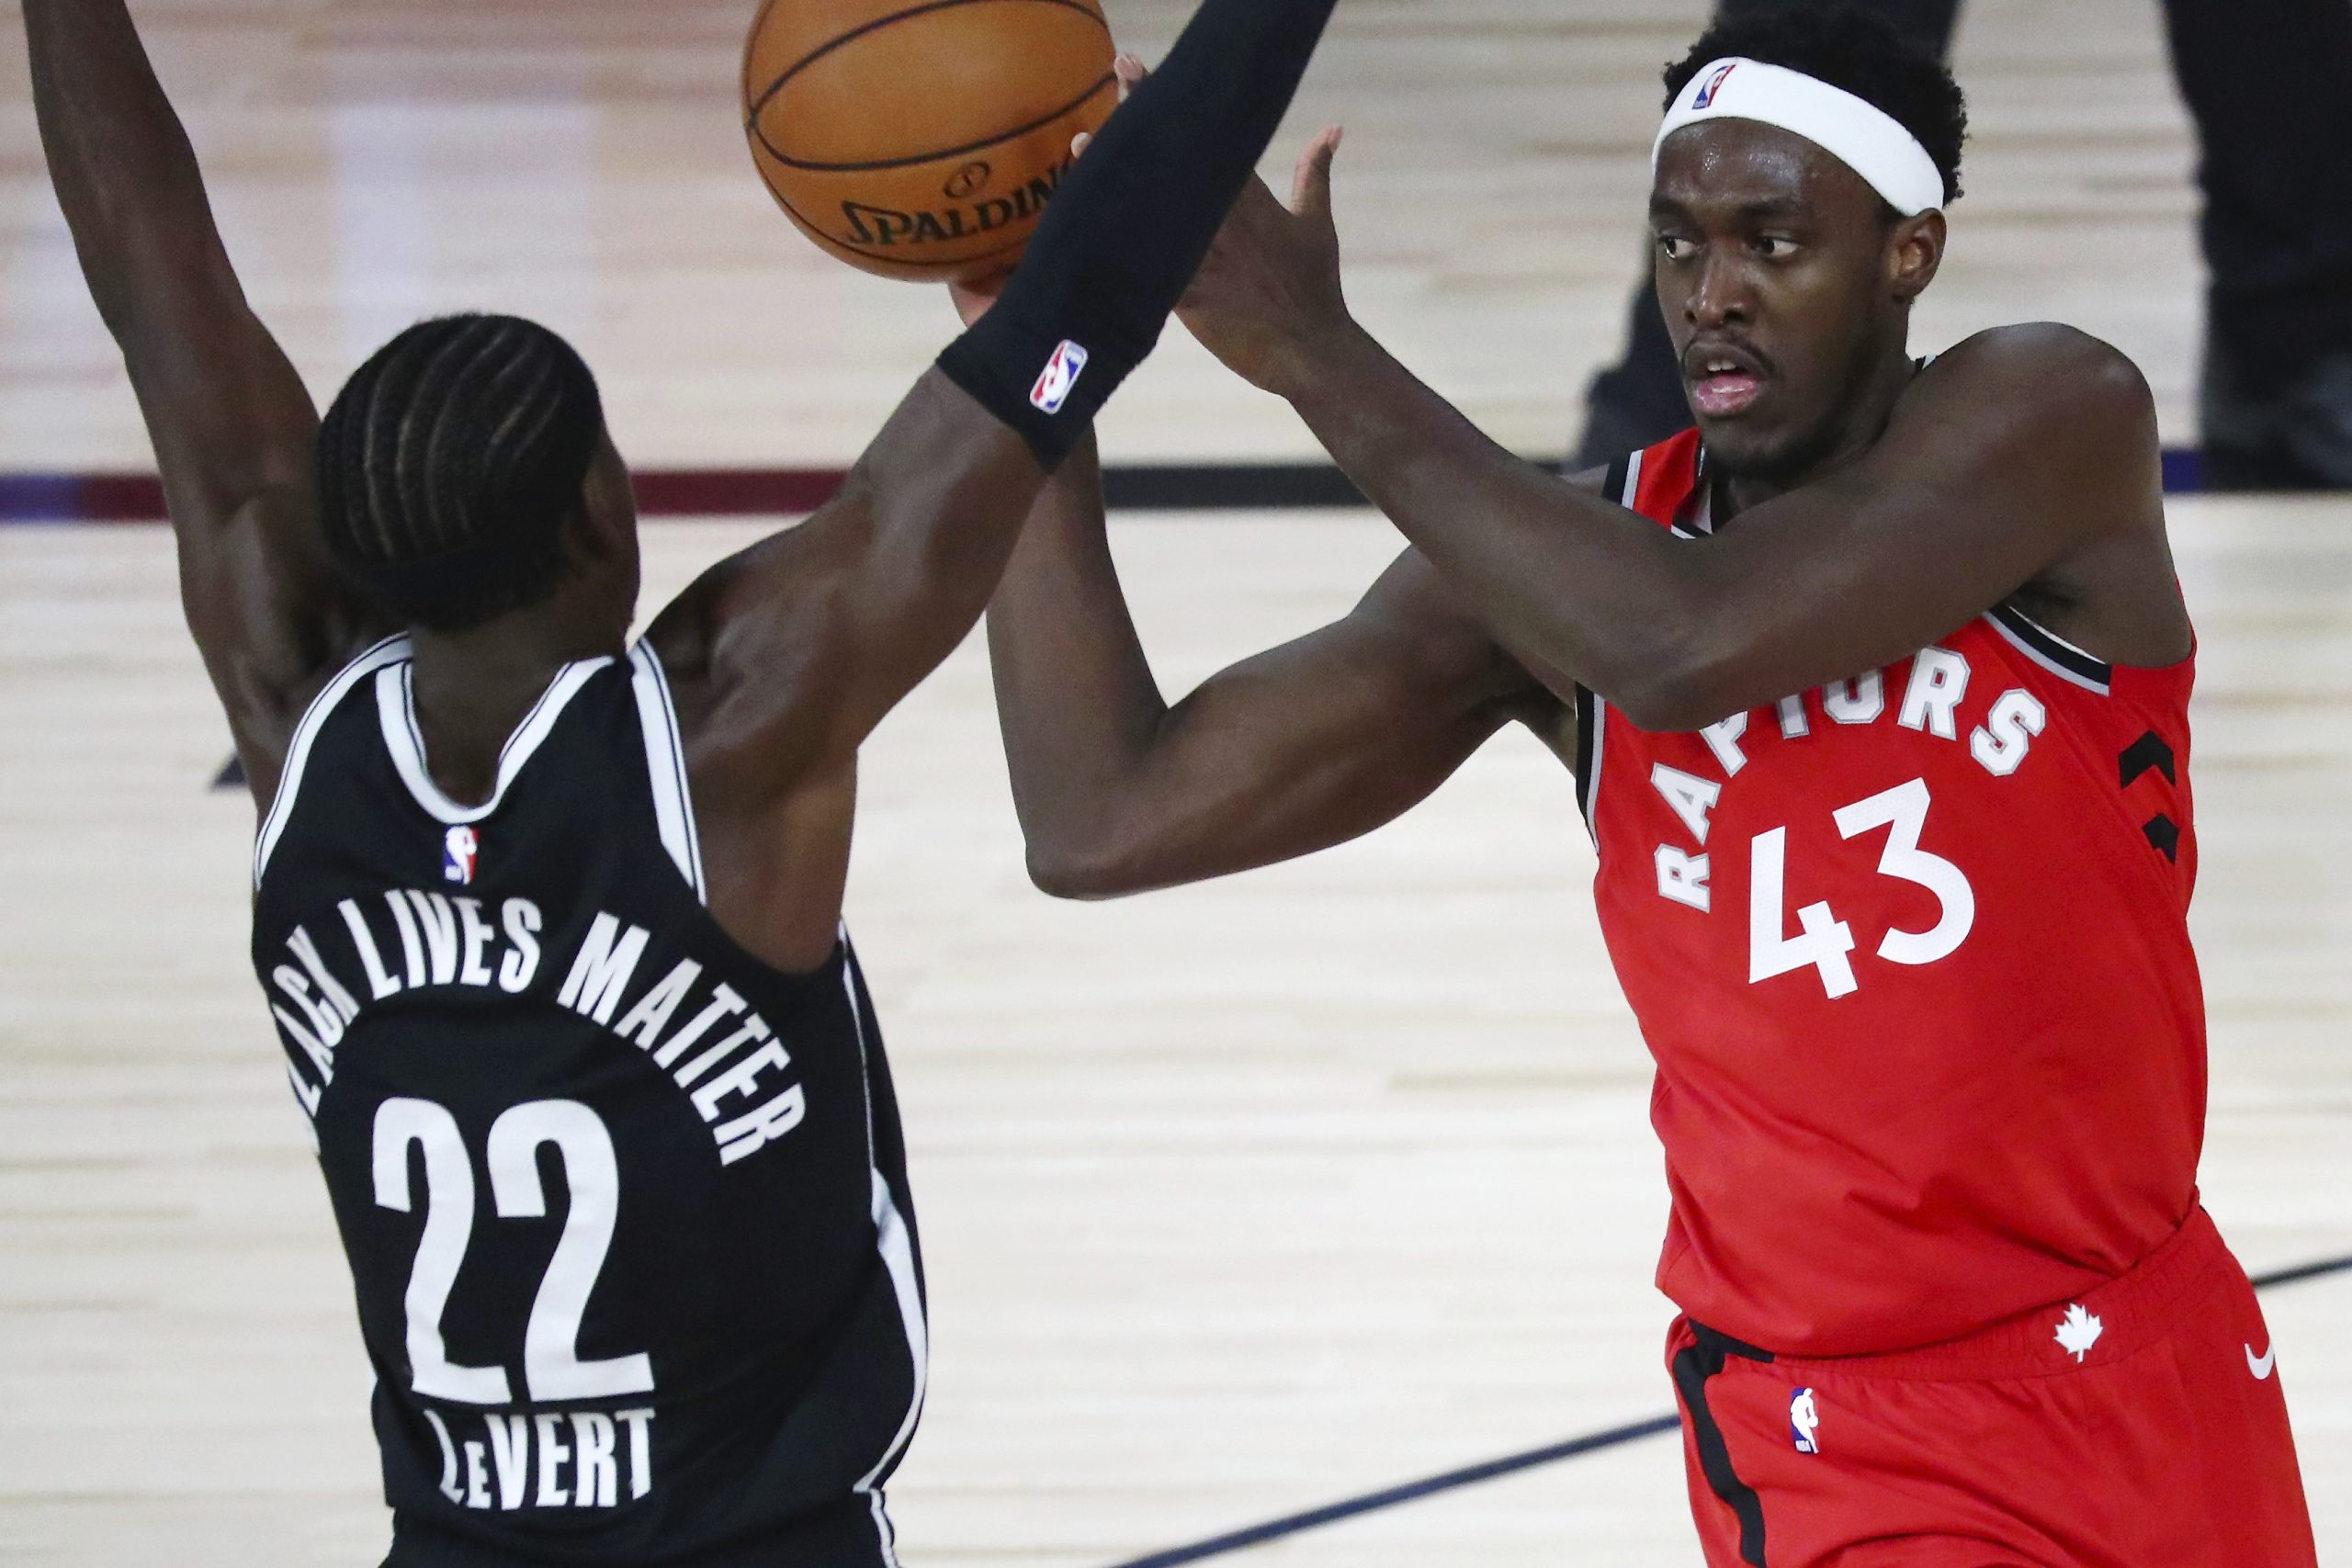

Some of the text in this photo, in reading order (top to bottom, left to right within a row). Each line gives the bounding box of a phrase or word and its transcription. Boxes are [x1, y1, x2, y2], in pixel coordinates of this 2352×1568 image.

[841, 161, 1072, 245] SPALDIN
[1748, 776, 1976, 999] 43
[272, 888, 807, 1167] LACK LIVES MATTER
[372, 1096, 655, 1404] 22
